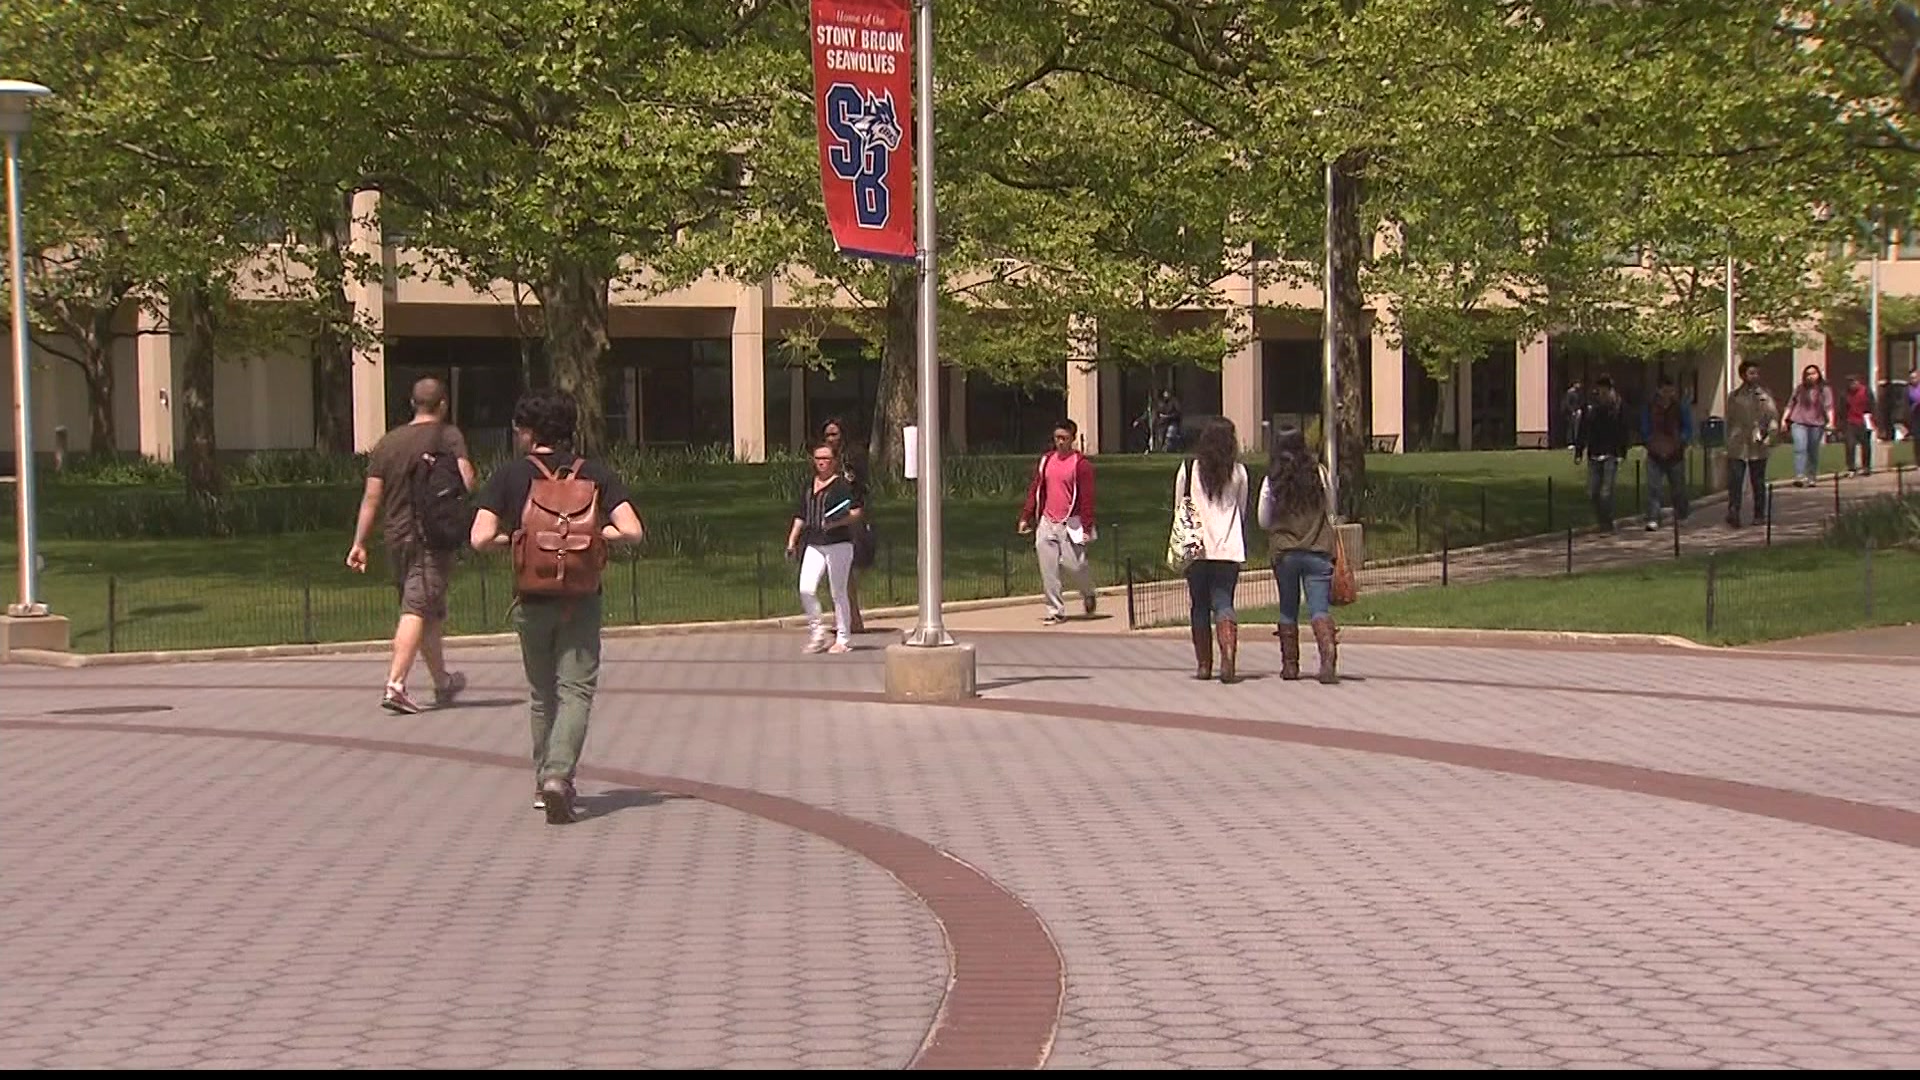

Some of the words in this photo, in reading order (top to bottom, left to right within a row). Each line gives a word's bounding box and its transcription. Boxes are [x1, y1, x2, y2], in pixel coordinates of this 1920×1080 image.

[836, 9, 860, 22] Home
[862, 13, 872, 27] of
[872, 15, 885, 26] the
[817, 25, 856, 48] STONY
[861, 29, 904, 53] BROOK
[826, 49, 896, 75] SEAWOLVES
